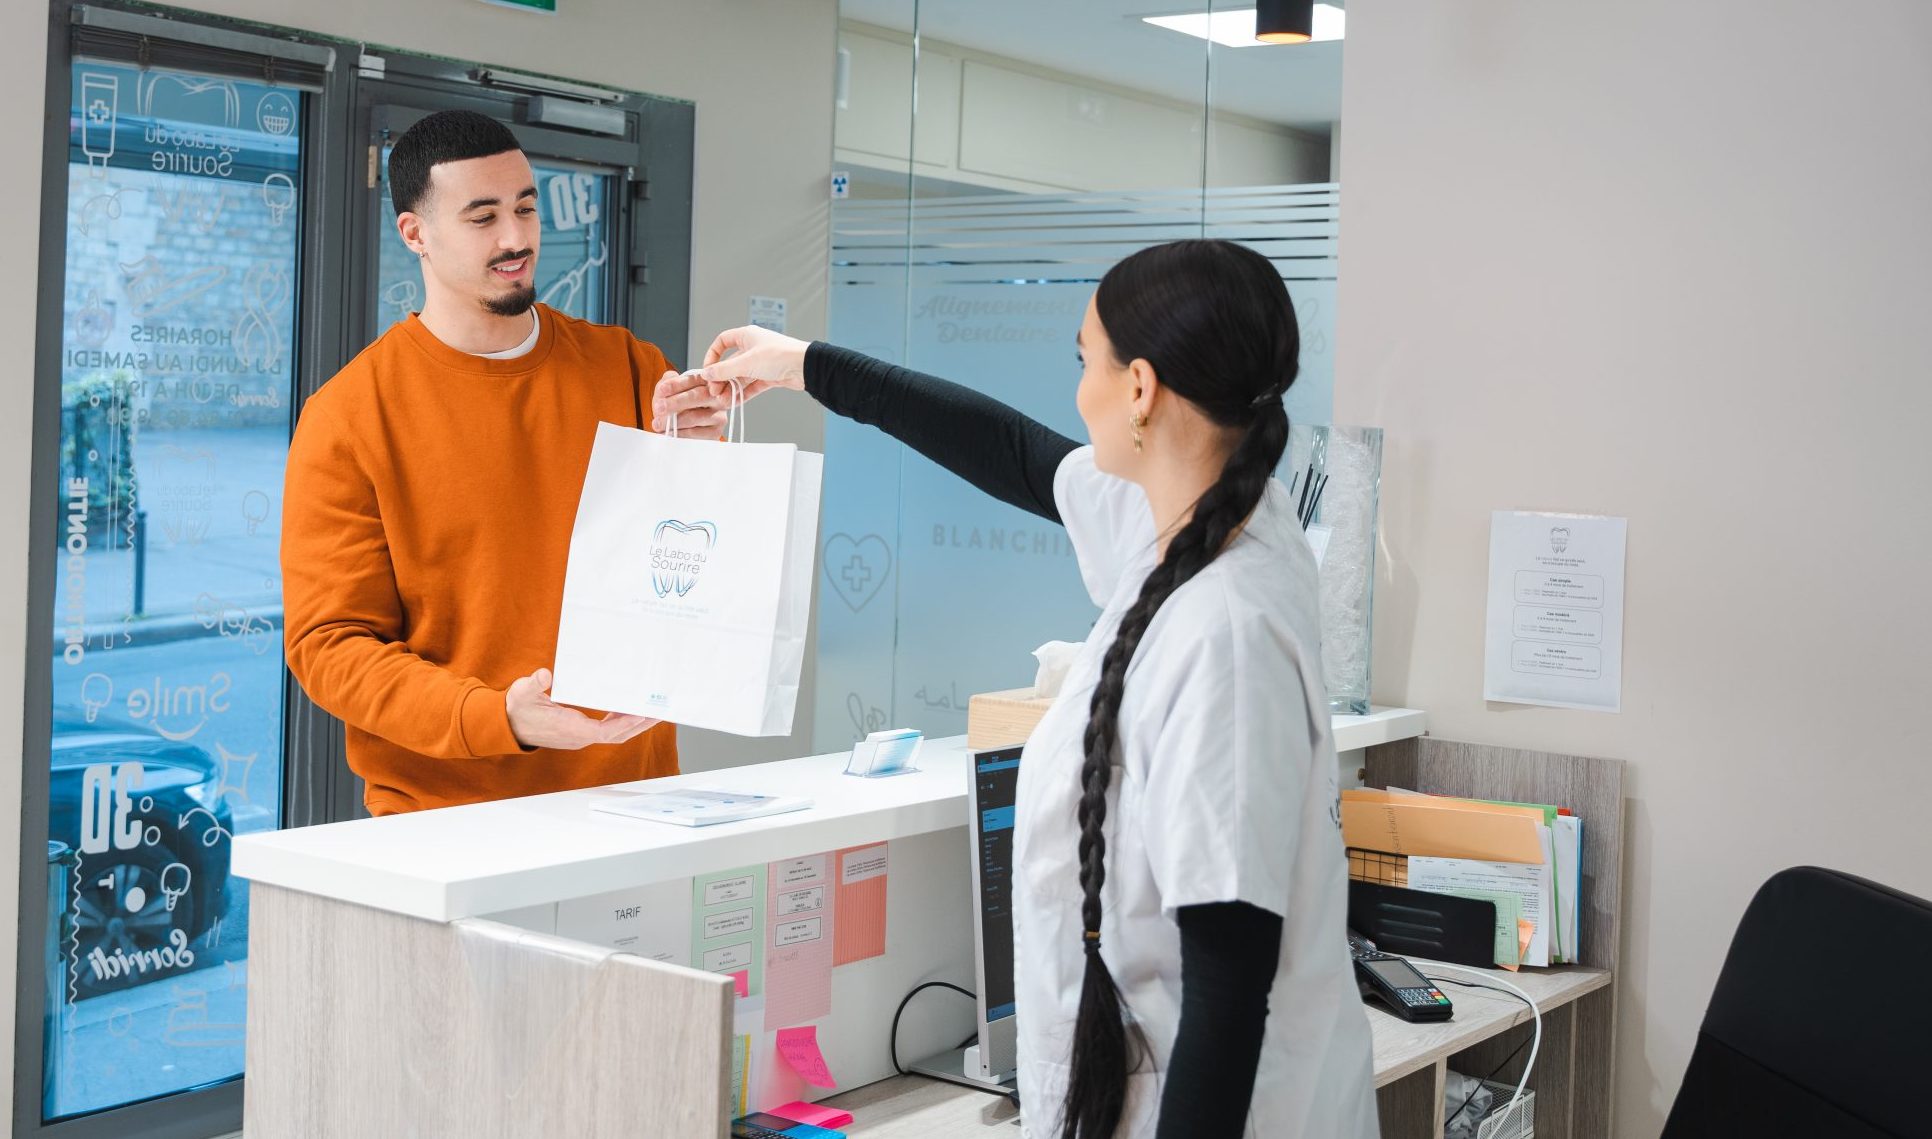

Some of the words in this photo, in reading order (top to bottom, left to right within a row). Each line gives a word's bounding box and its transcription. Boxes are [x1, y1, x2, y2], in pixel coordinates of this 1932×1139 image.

[936, 321, 1059, 344] Dentaire
[932, 524, 1074, 556] BLANCHI
[649, 545, 663, 556] Le
[664, 546, 691, 561] Labo
[692, 551, 707, 563] du
[651, 555, 700, 575] Sourire
[614, 906, 642, 921] TARIF
